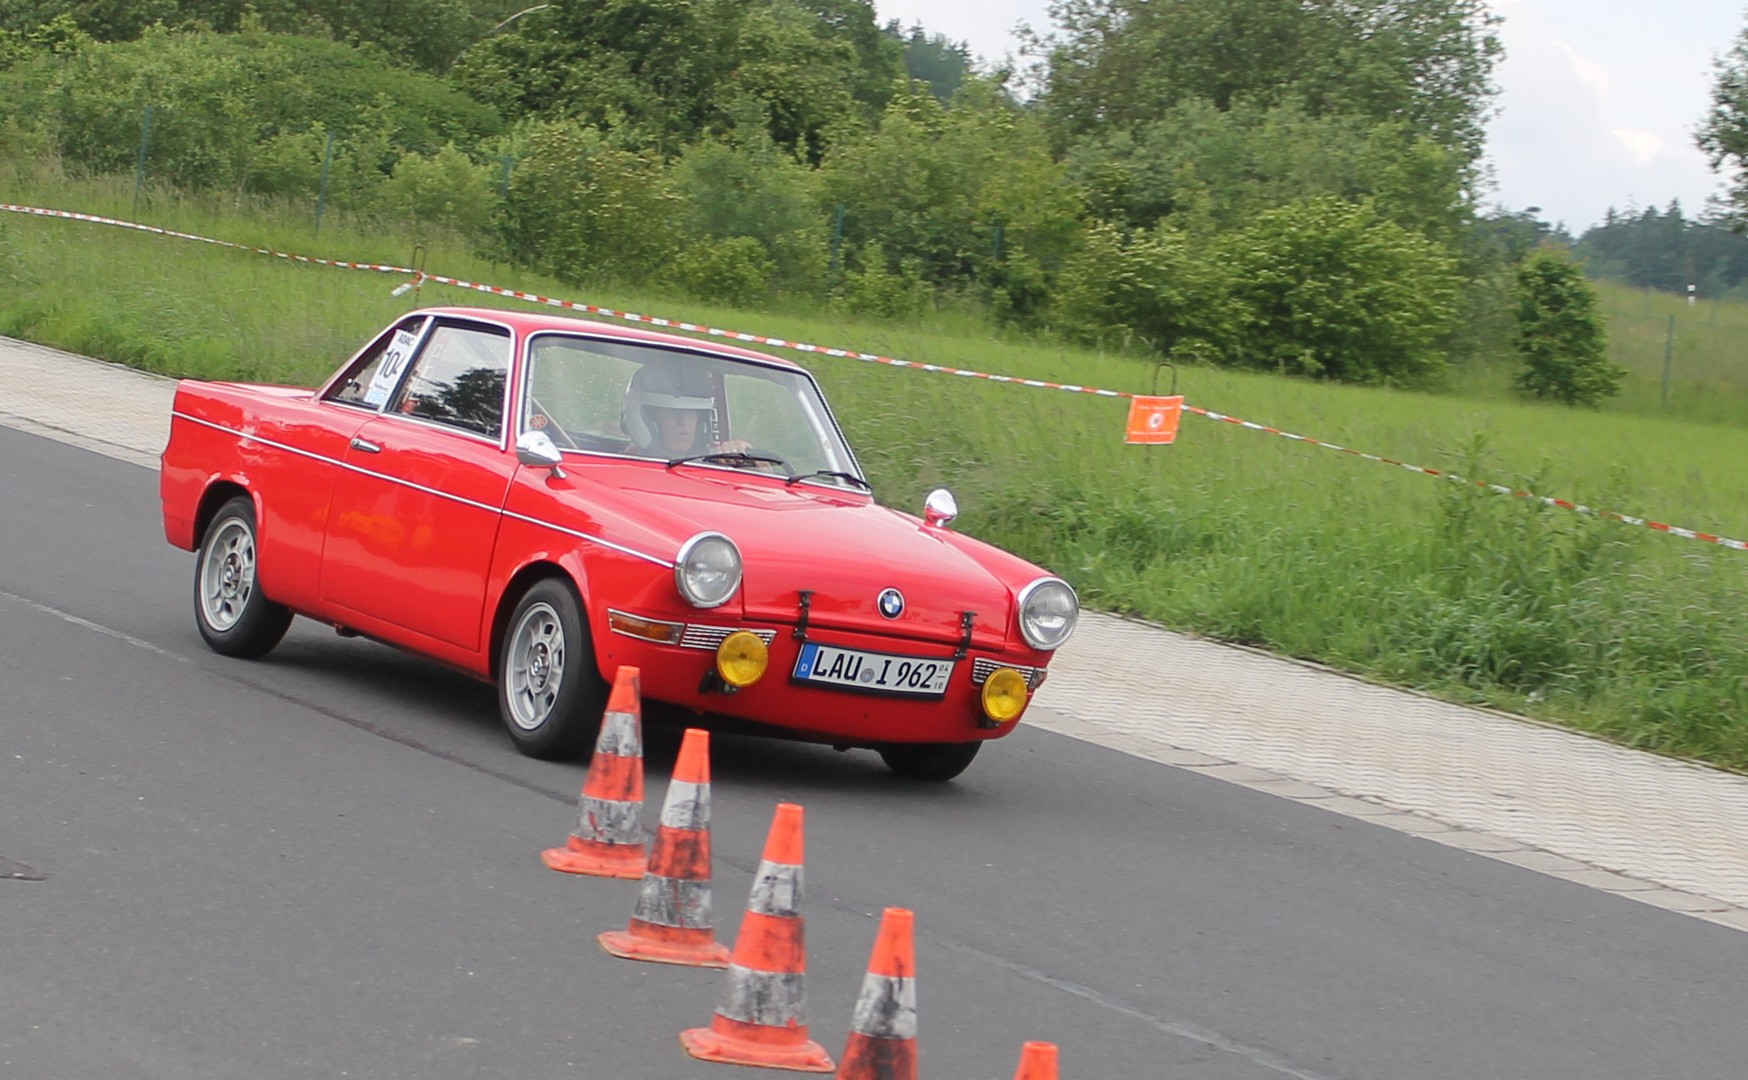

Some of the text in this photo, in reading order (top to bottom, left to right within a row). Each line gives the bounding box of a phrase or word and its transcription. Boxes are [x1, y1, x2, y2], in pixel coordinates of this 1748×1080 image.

[800, 663, 808, 672] D
[812, 650, 938, 689] LAU I 962
